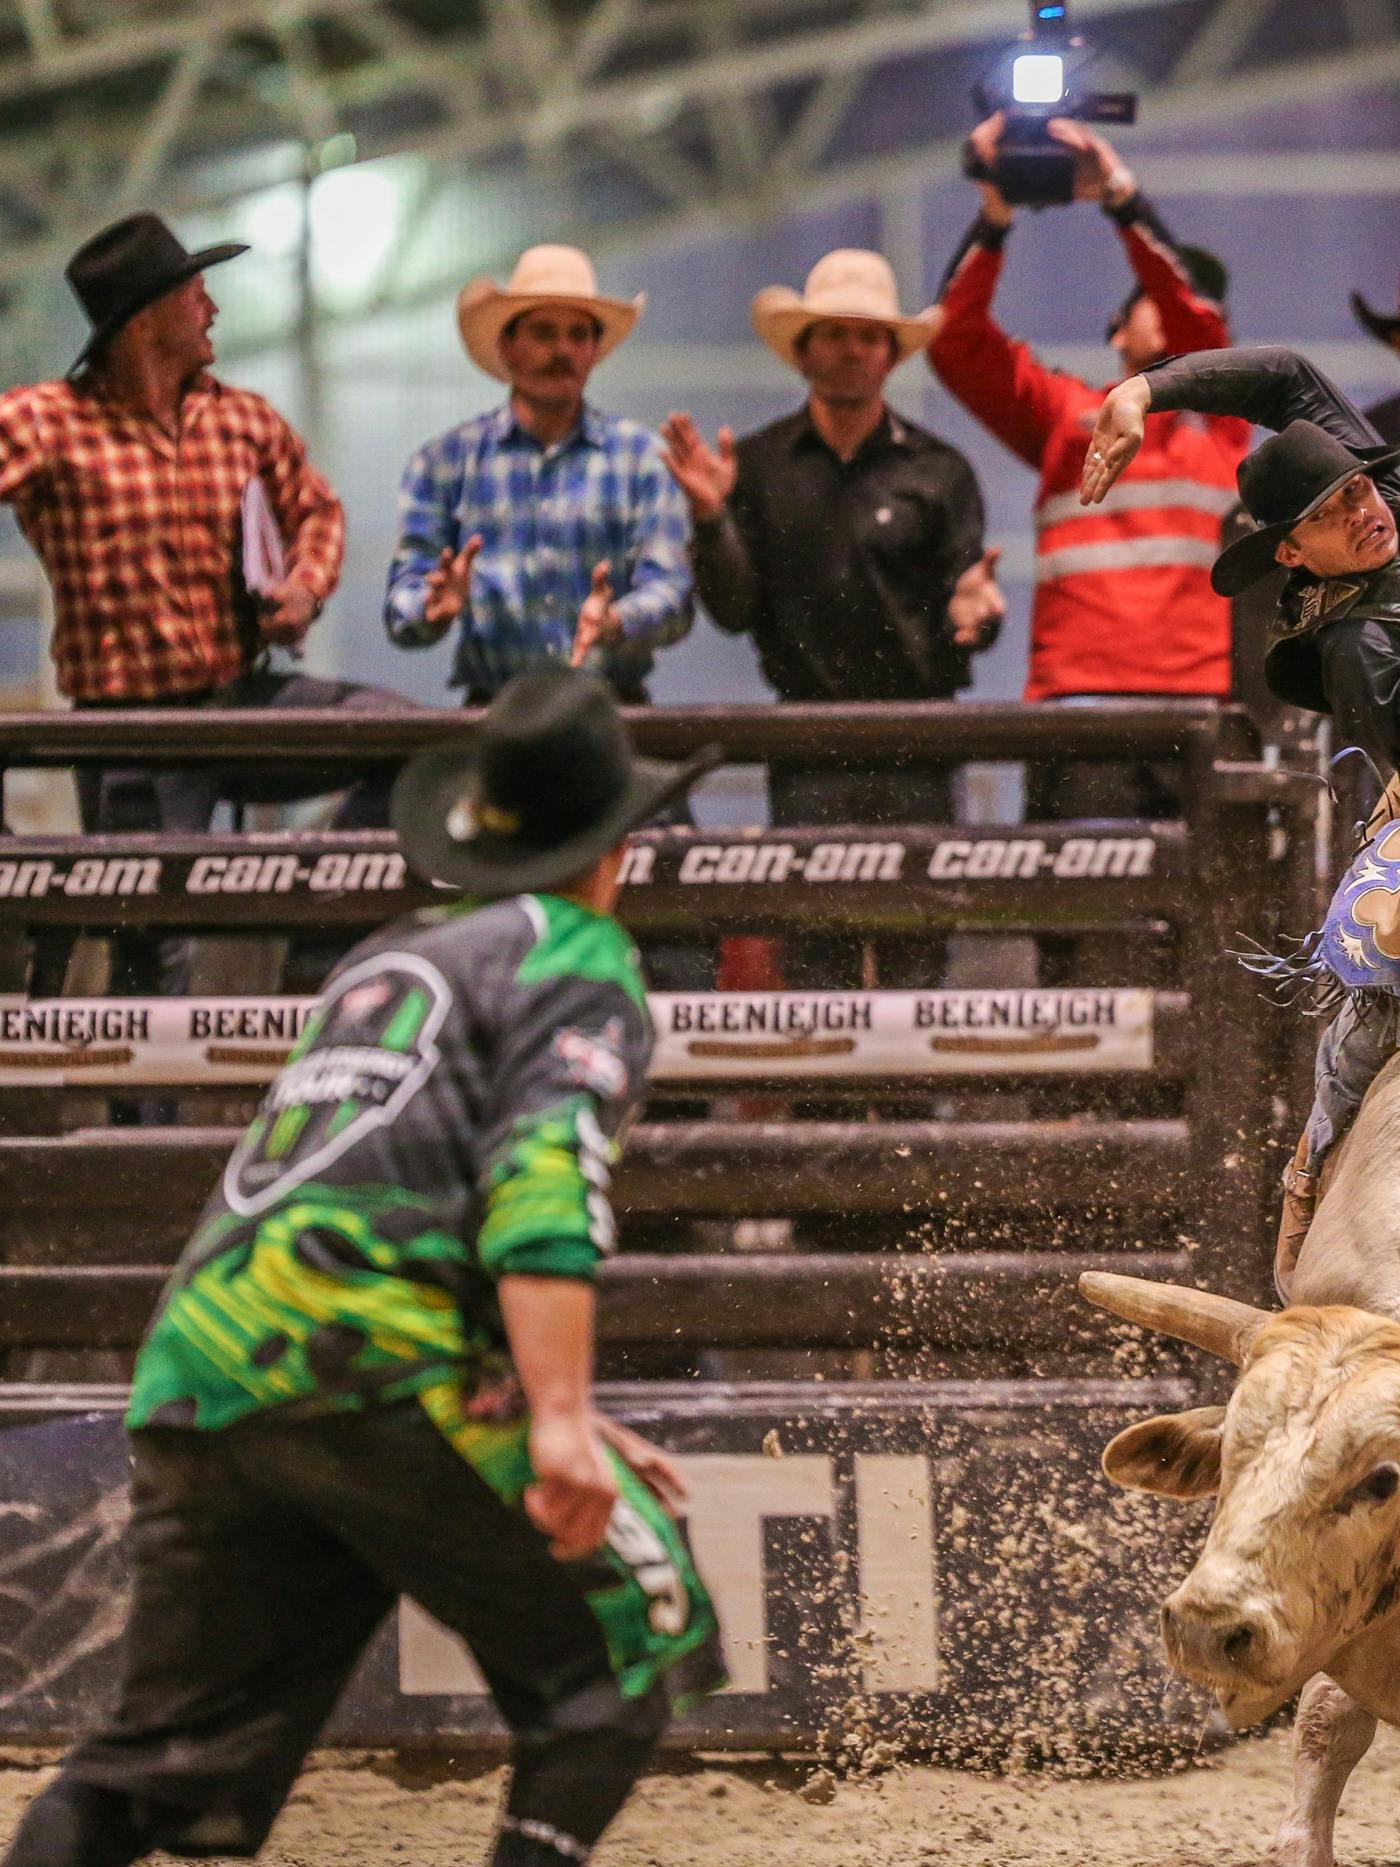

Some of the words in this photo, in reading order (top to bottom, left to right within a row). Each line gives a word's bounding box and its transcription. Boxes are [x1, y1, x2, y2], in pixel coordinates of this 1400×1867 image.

[185, 852, 408, 895] can-am
[678, 841, 905, 885] can-am
[927, 837, 1157, 880] can-am
[189, 1007, 315, 1041] BEENL
[670, 999, 873, 1036] BEENLEIGH
[913, 994, 1118, 1032] BEENLEIGH
